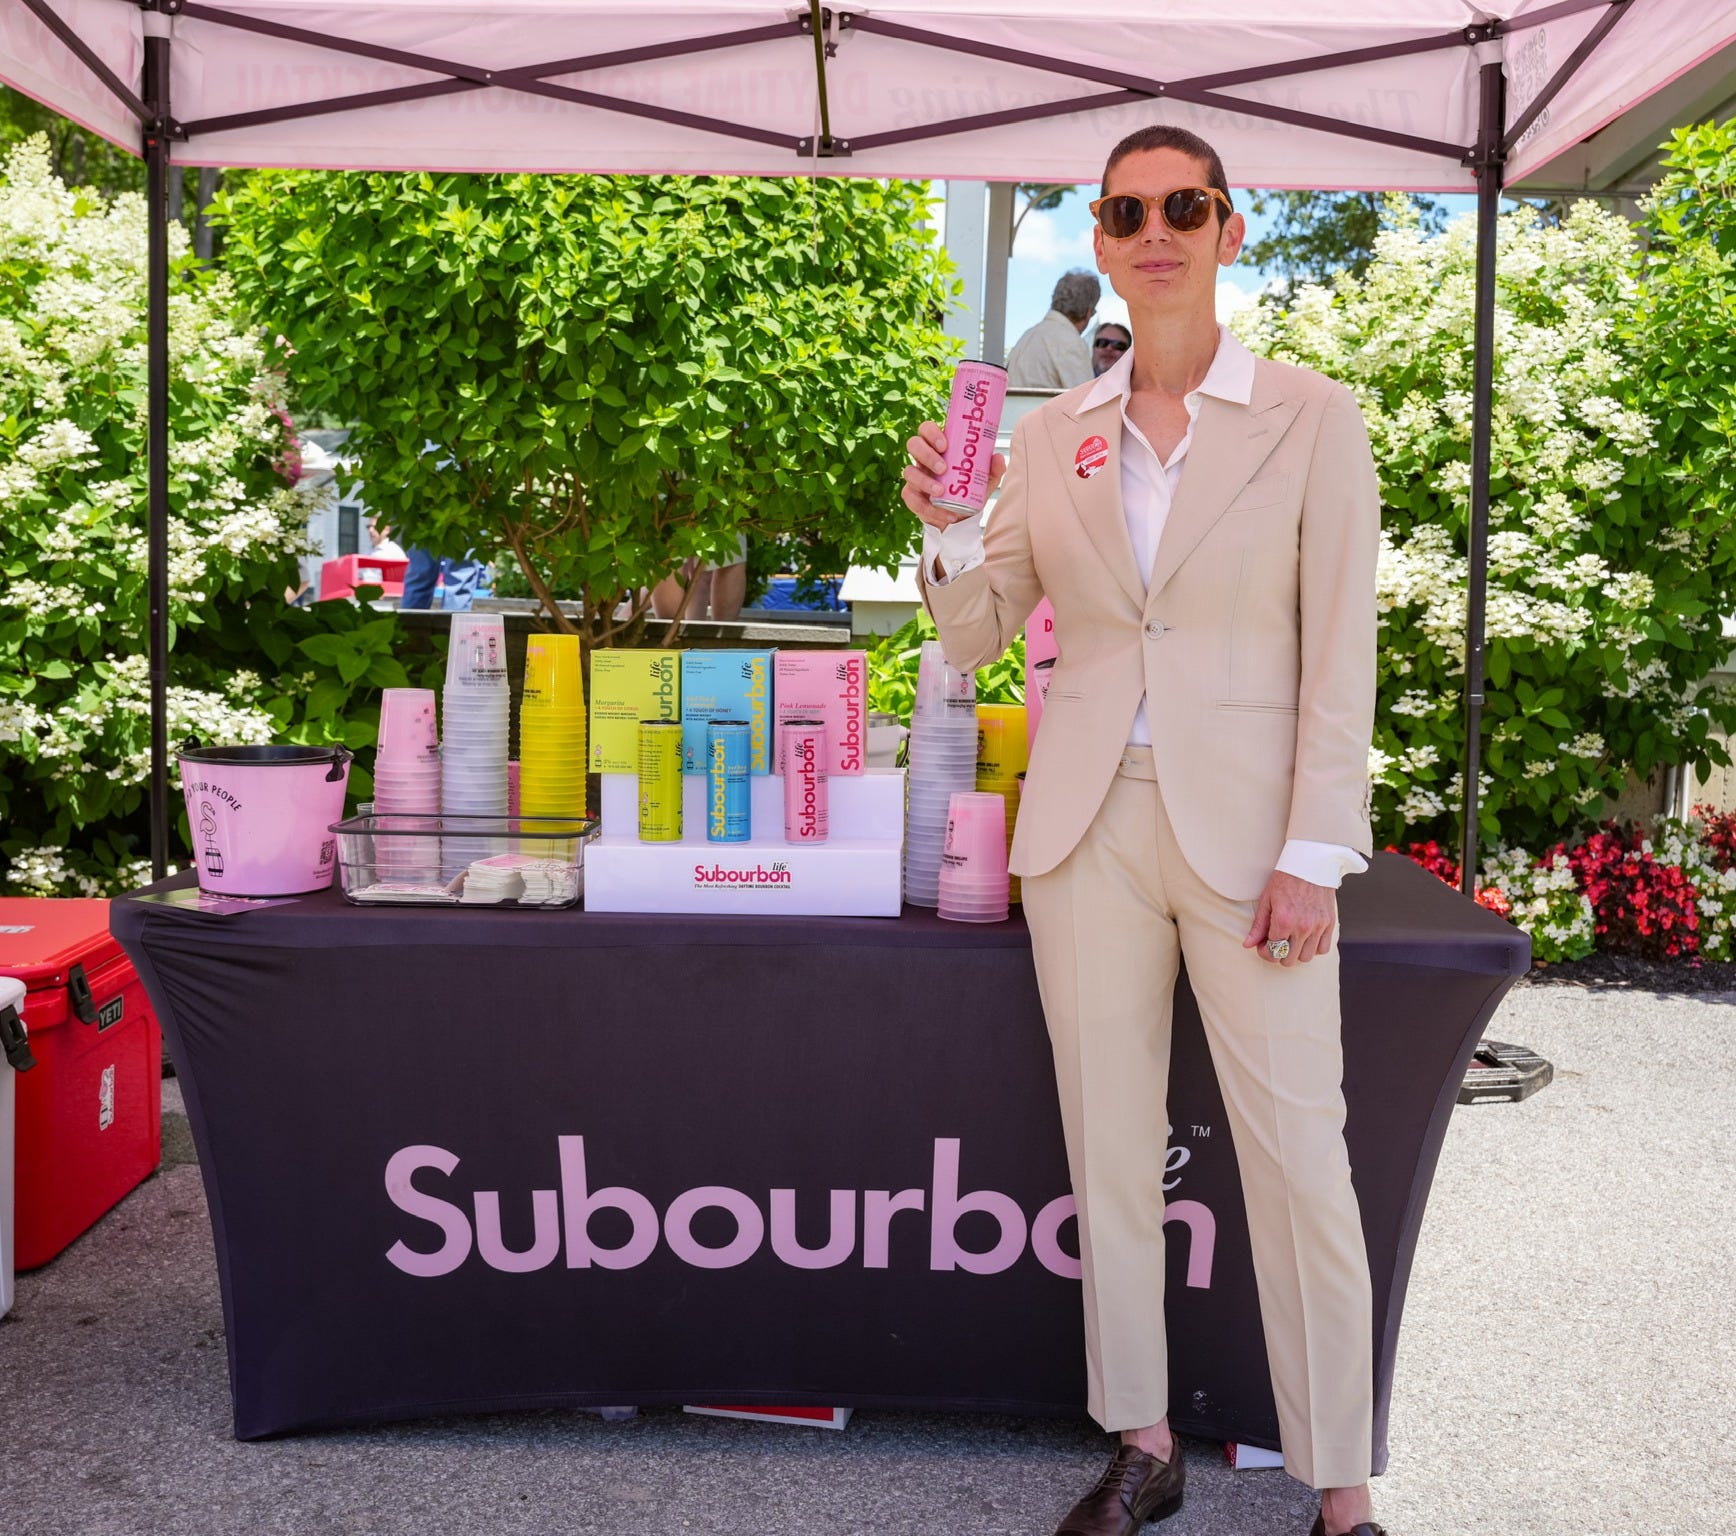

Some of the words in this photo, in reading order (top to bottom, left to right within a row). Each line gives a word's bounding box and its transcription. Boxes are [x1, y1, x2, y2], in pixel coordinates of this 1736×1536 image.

[964, 384, 976, 401] life
[948, 379, 991, 499] Subourbon
[649, 661, 660, 678] life
[741, 663, 752, 680] life
[836, 664, 846, 681] life
[839, 659, 860, 770] Subourbon
[794, 742, 804, 758] life
[191, 781, 209, 793] YOUR
[212, 785, 243, 812] PEOPLE
[710, 738, 726, 838] Subourbon
[797, 738, 816, 837] Subourbon
[694, 864, 791, 883] Subourbon
[772, 862, 787, 872] life
[99, 1002, 121, 1027] YETI
